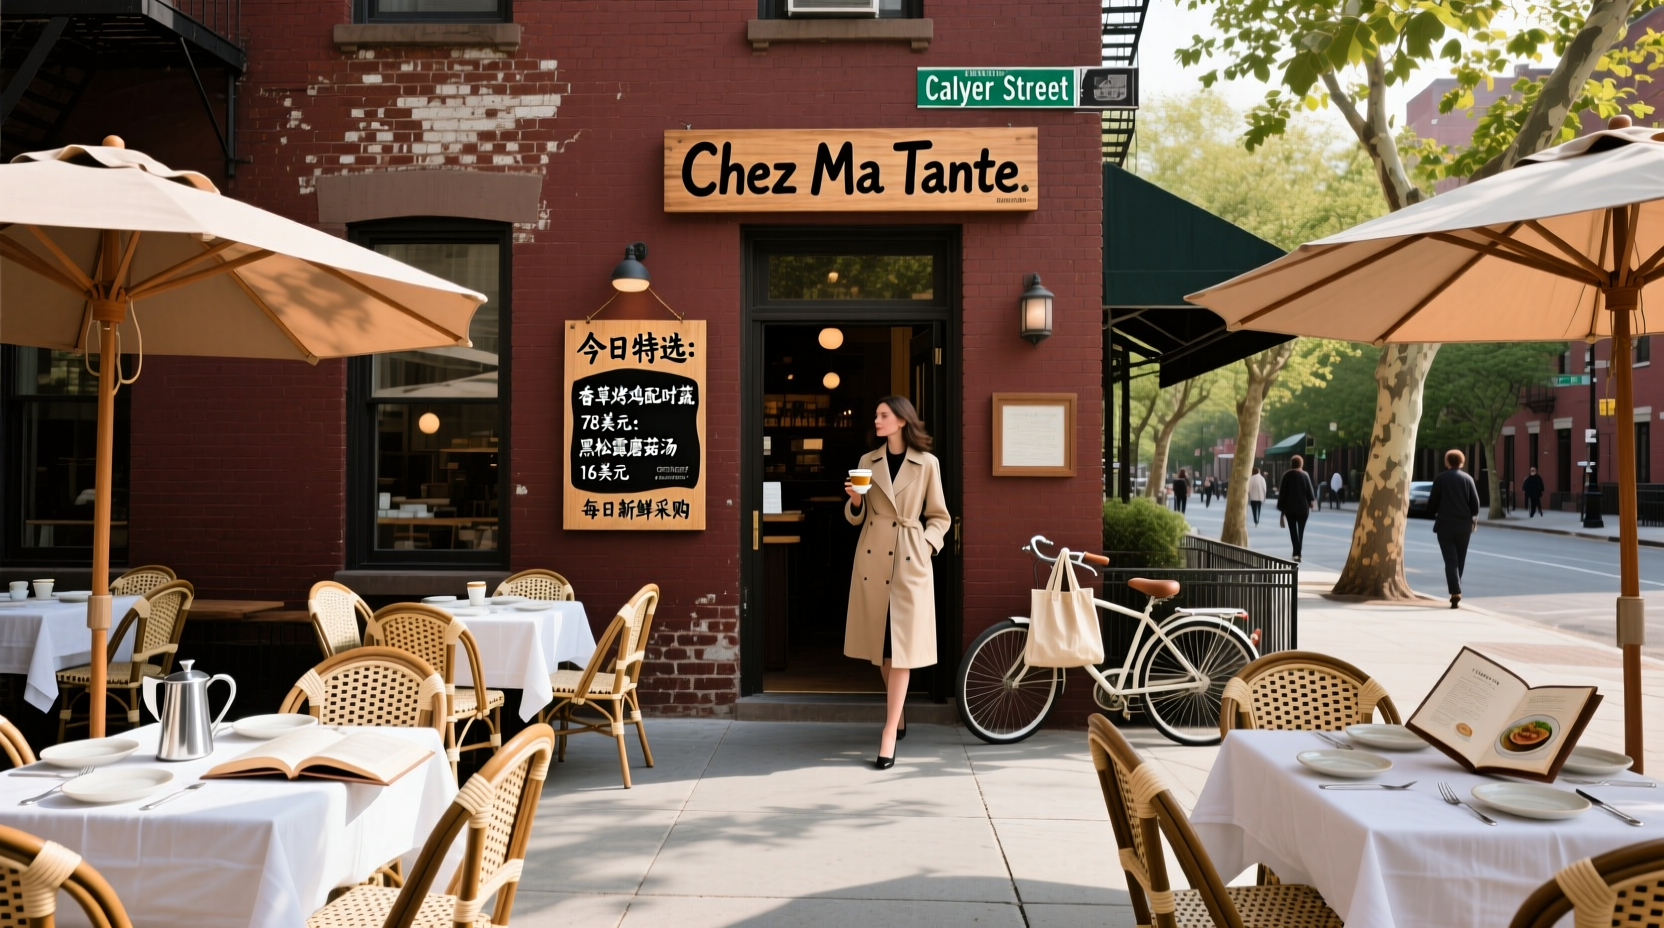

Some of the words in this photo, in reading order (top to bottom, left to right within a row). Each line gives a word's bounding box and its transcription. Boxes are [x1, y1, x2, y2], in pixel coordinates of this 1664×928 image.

[925, 74, 994, 107] Calyer
[1003, 75, 1069, 101] Street
[682, 141, 797, 197] Chez
[811, 141, 885, 196] Ma
[577, 332, 695, 365] 今日特选：
[580, 463, 630, 481] 16美元
[582, 499, 690, 521] 每日新鲜采购
